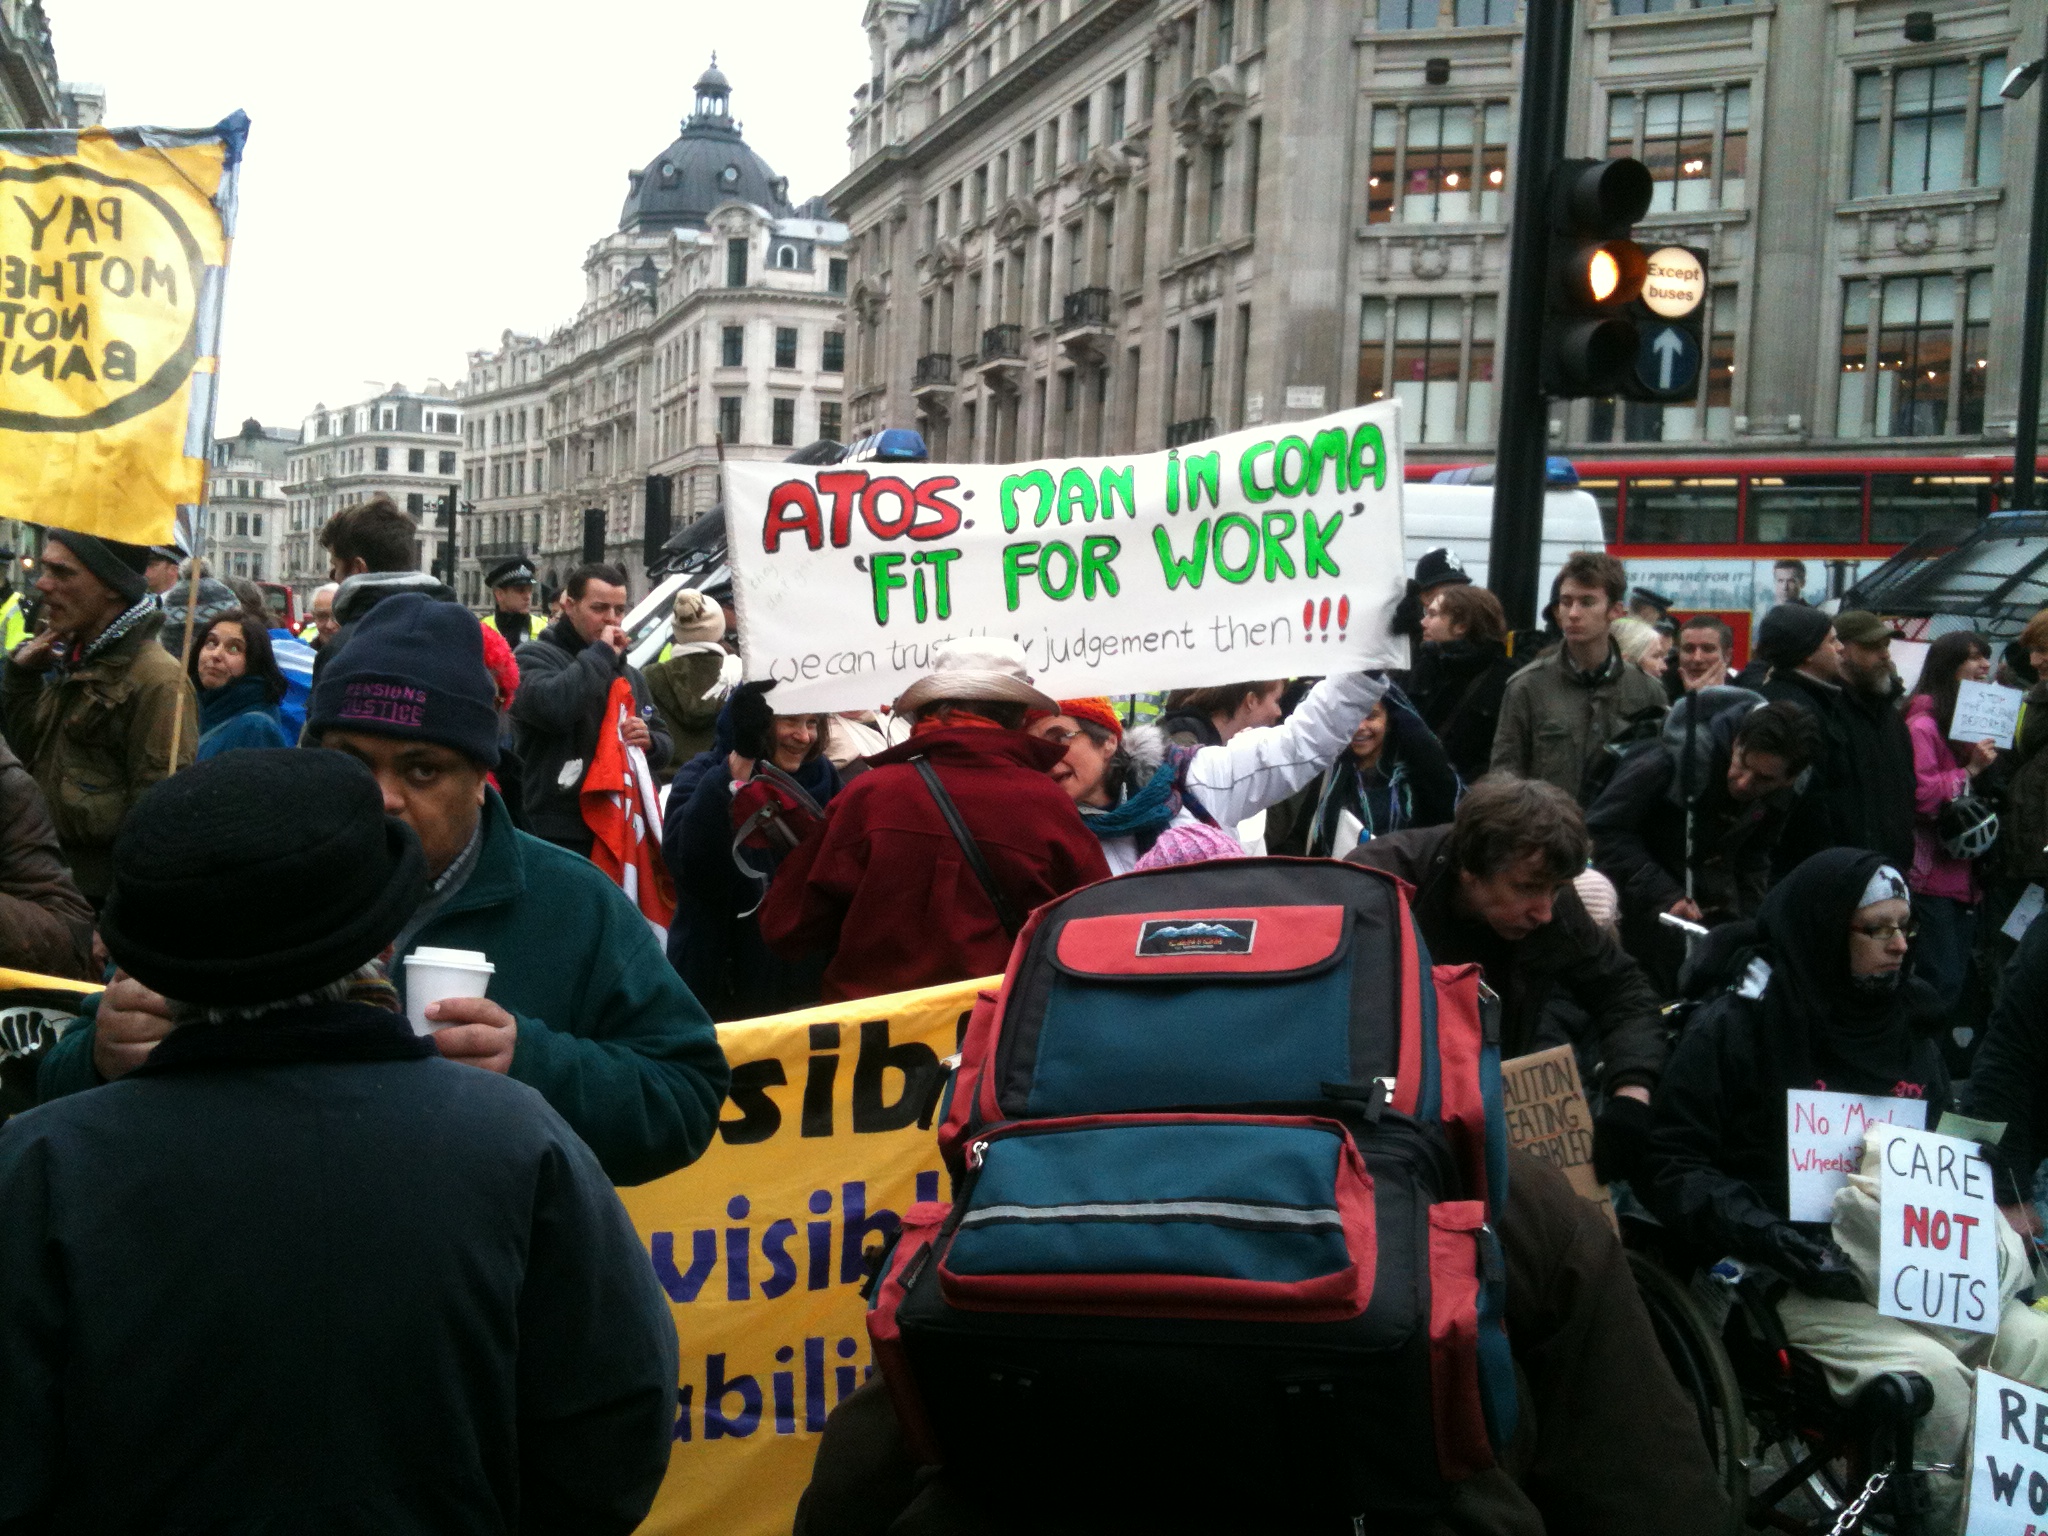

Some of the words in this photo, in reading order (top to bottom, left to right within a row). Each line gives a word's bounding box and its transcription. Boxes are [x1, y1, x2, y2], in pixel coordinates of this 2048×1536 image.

[1647, 262, 1700, 282] Except
[1649, 284, 1694, 302] buses
[762, 469, 976, 555] ATOS:
[999, 464, 1136, 535] MAN
[1238, 422, 1387, 504] COMA
[1002, 534, 1122, 612] FOR
[1038, 620, 1196, 673] judgement
[1209, 614, 1292, 652] then
[342, 699, 425, 724] JUSTICE
[345, 683, 427, 704] PENSIONS
[718, 1009, 972, 1145] sib
[1794, 1102, 1830, 1135] No
[1886, 1136, 1984, 1200] CARE
[1903, 1203, 1980, 1261] NOT
[1893, 1264, 1987, 1324] CUTS
[671, 1336, 875, 1443] bili
